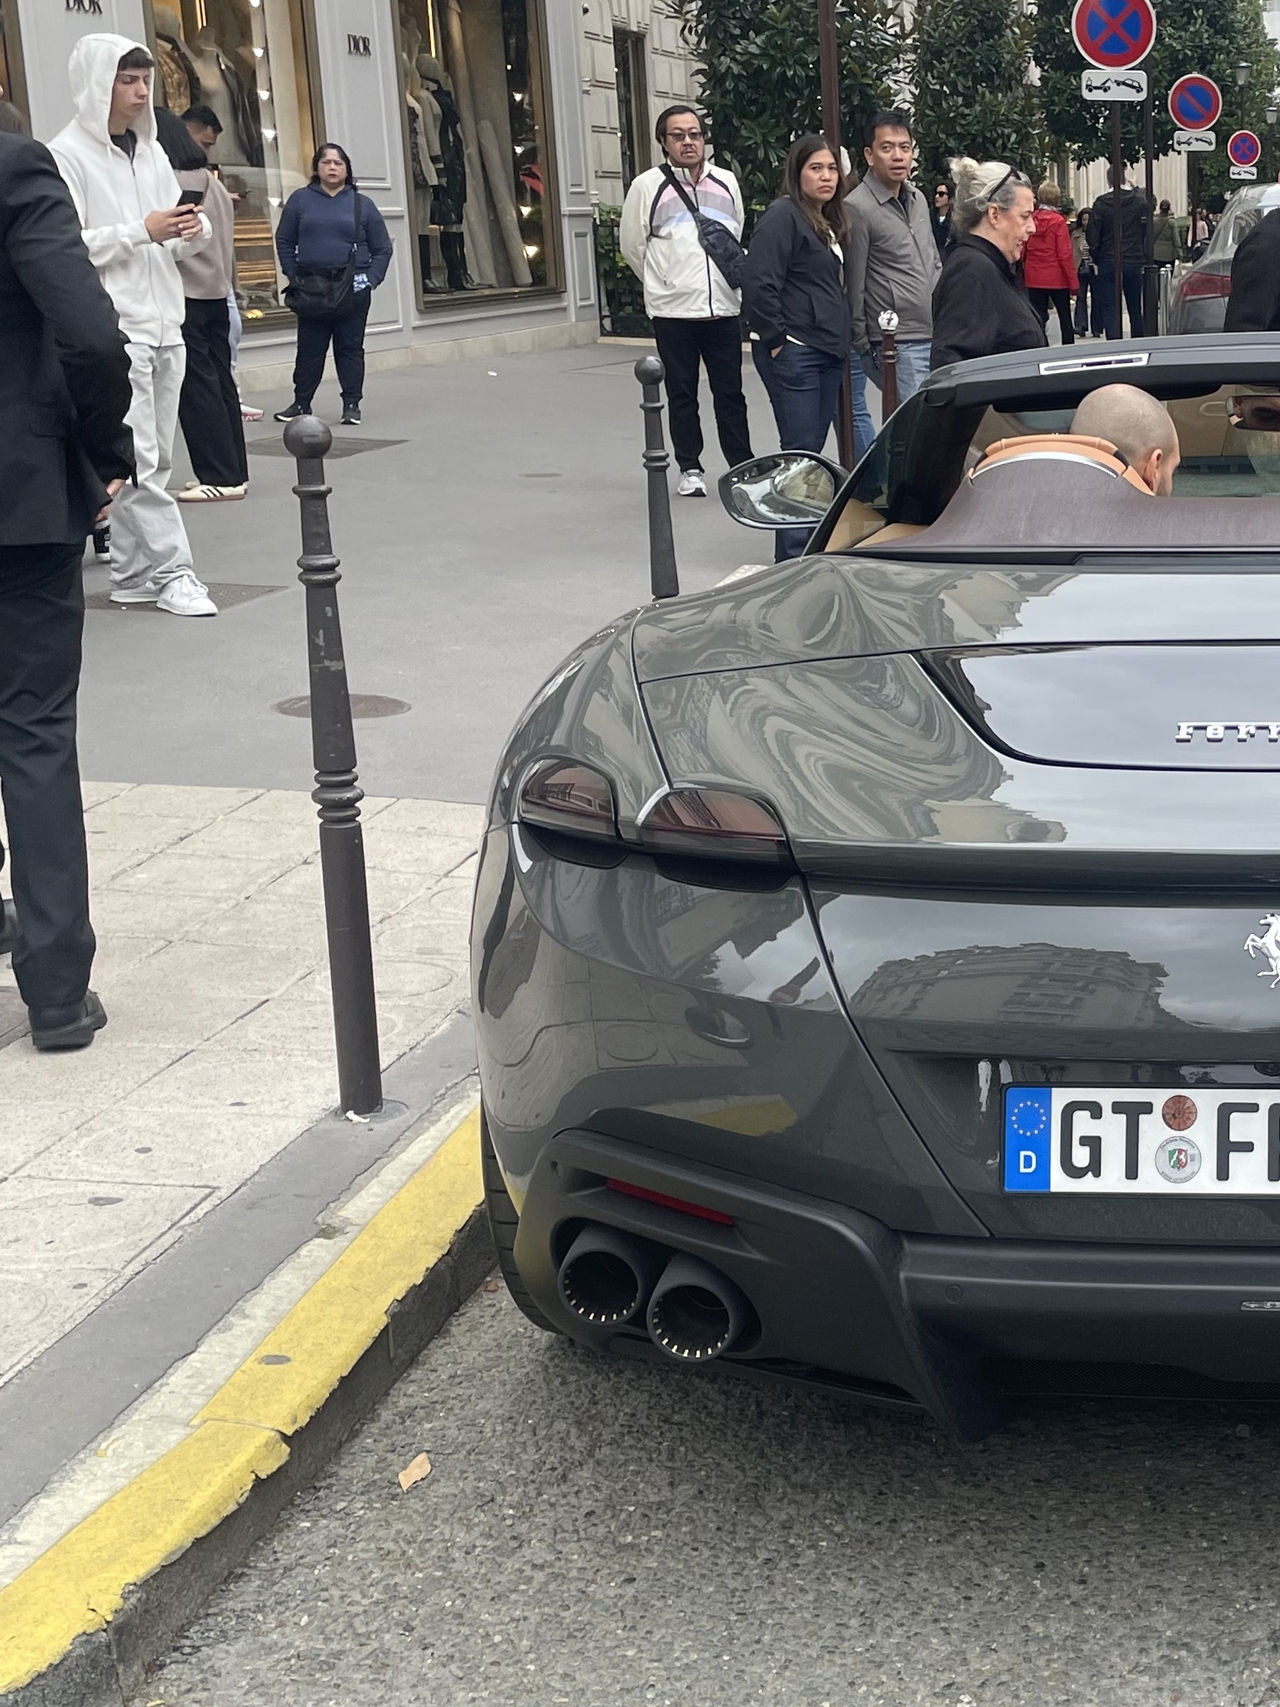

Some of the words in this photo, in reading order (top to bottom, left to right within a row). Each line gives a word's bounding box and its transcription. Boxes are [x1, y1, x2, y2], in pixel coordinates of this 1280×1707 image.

[347, 33, 372, 56] DIOR
[1059, 1100, 1154, 1180] GT
[1019, 1150, 1037, 1173] D
